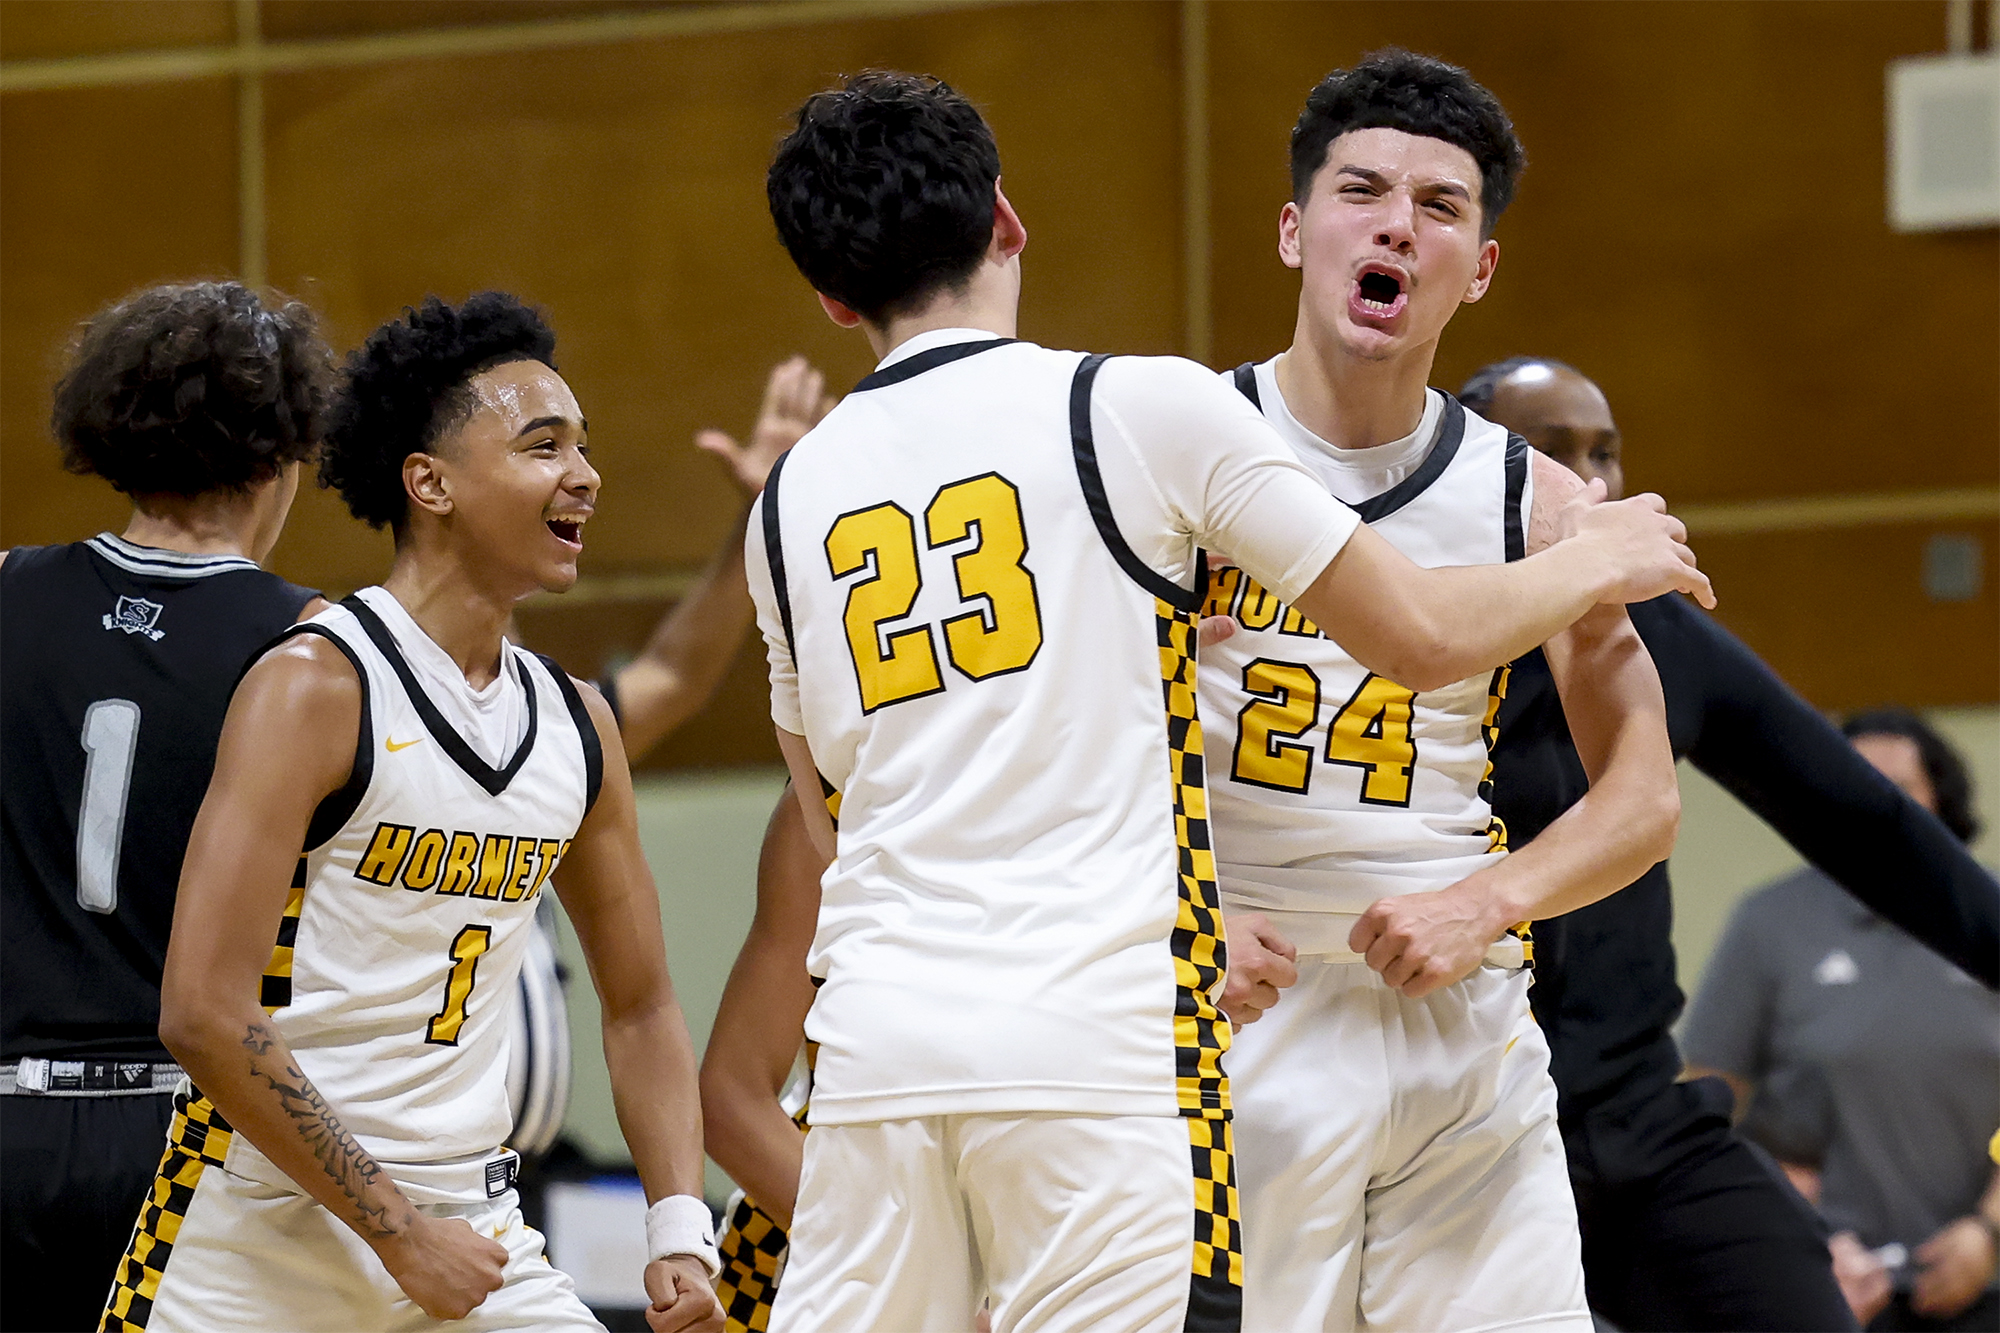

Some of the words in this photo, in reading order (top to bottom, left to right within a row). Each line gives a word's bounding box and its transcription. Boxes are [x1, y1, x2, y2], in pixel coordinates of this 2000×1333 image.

[823, 471, 1044, 717] 23
[76, 698, 141, 915] 1
[1230, 657, 1418, 808] 24
[353, 822, 574, 902] HORNET
[424, 924, 492, 1047] 1
